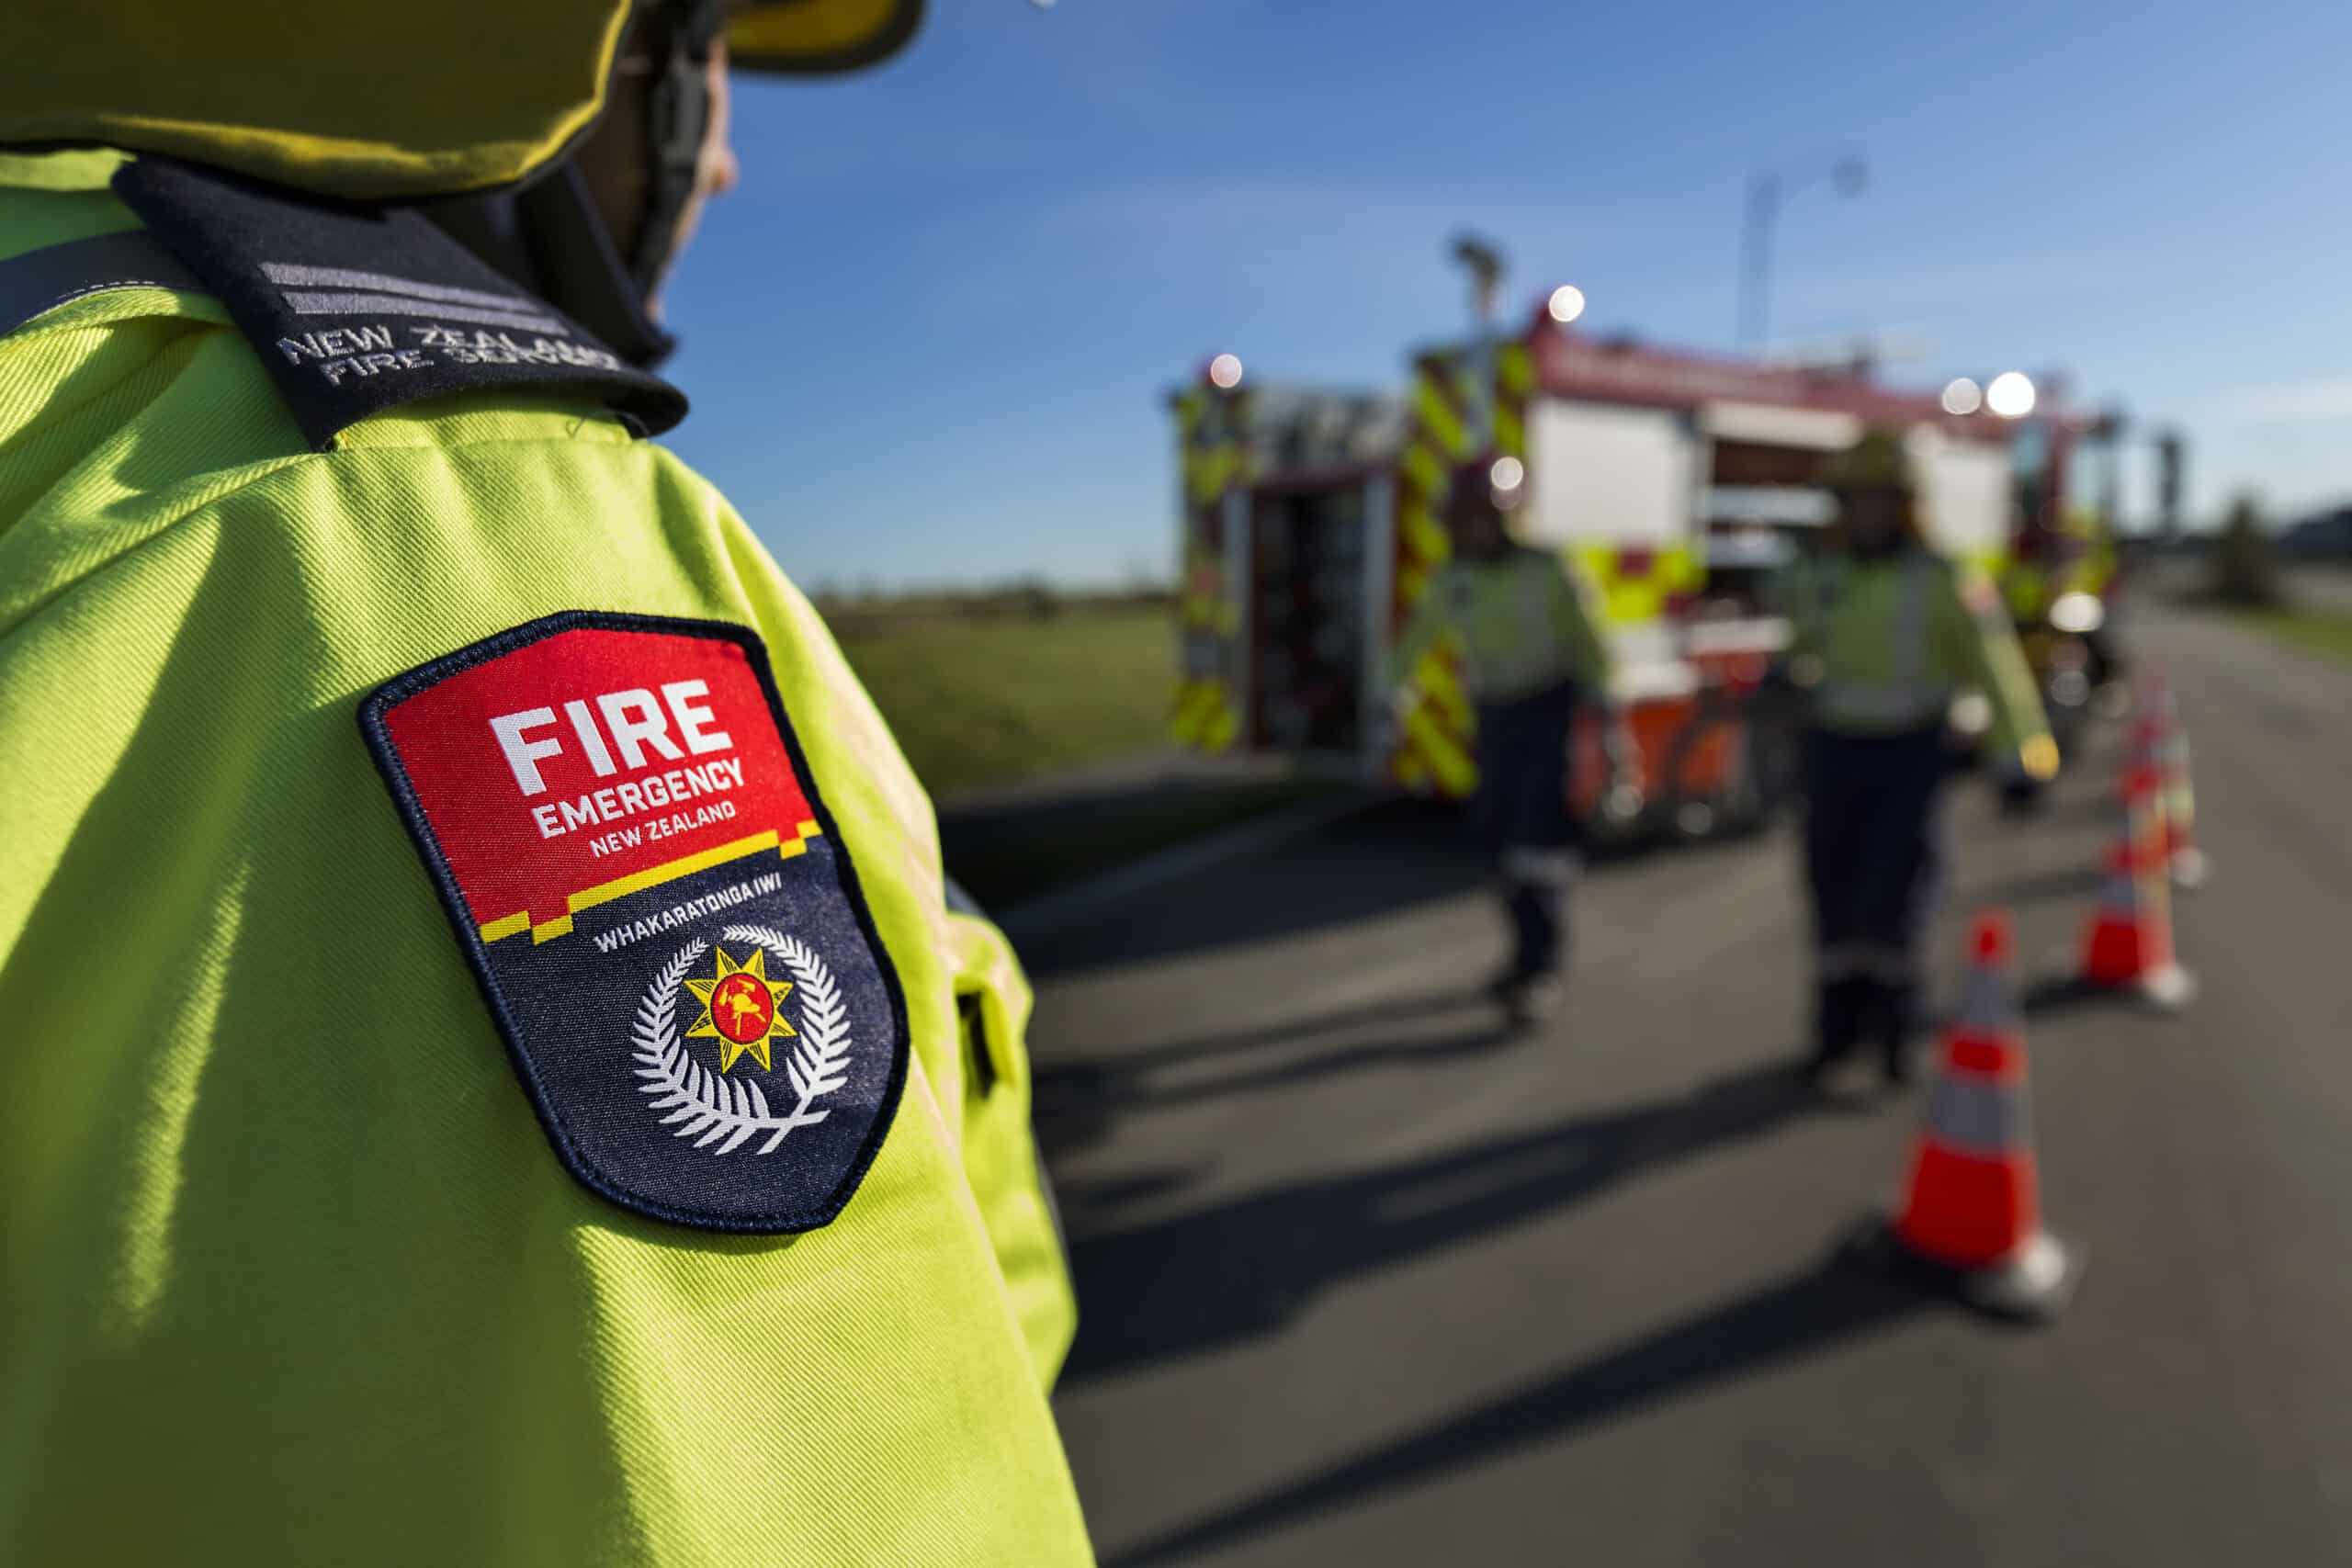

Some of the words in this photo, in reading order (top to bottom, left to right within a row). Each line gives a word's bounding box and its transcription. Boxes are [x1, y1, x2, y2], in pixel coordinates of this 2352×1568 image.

[277, 324, 393, 365] NEW
[321, 350, 434, 387] FIRE
[489, 679, 733, 796] FIRE
[531, 758, 744, 839] EMERGENCY
[589, 827, 641, 858] NEW
[645, 801, 736, 840] ZEALAND
[593, 883, 754, 953] WHAKARATONGA
[753, 872, 782, 896] IWI
